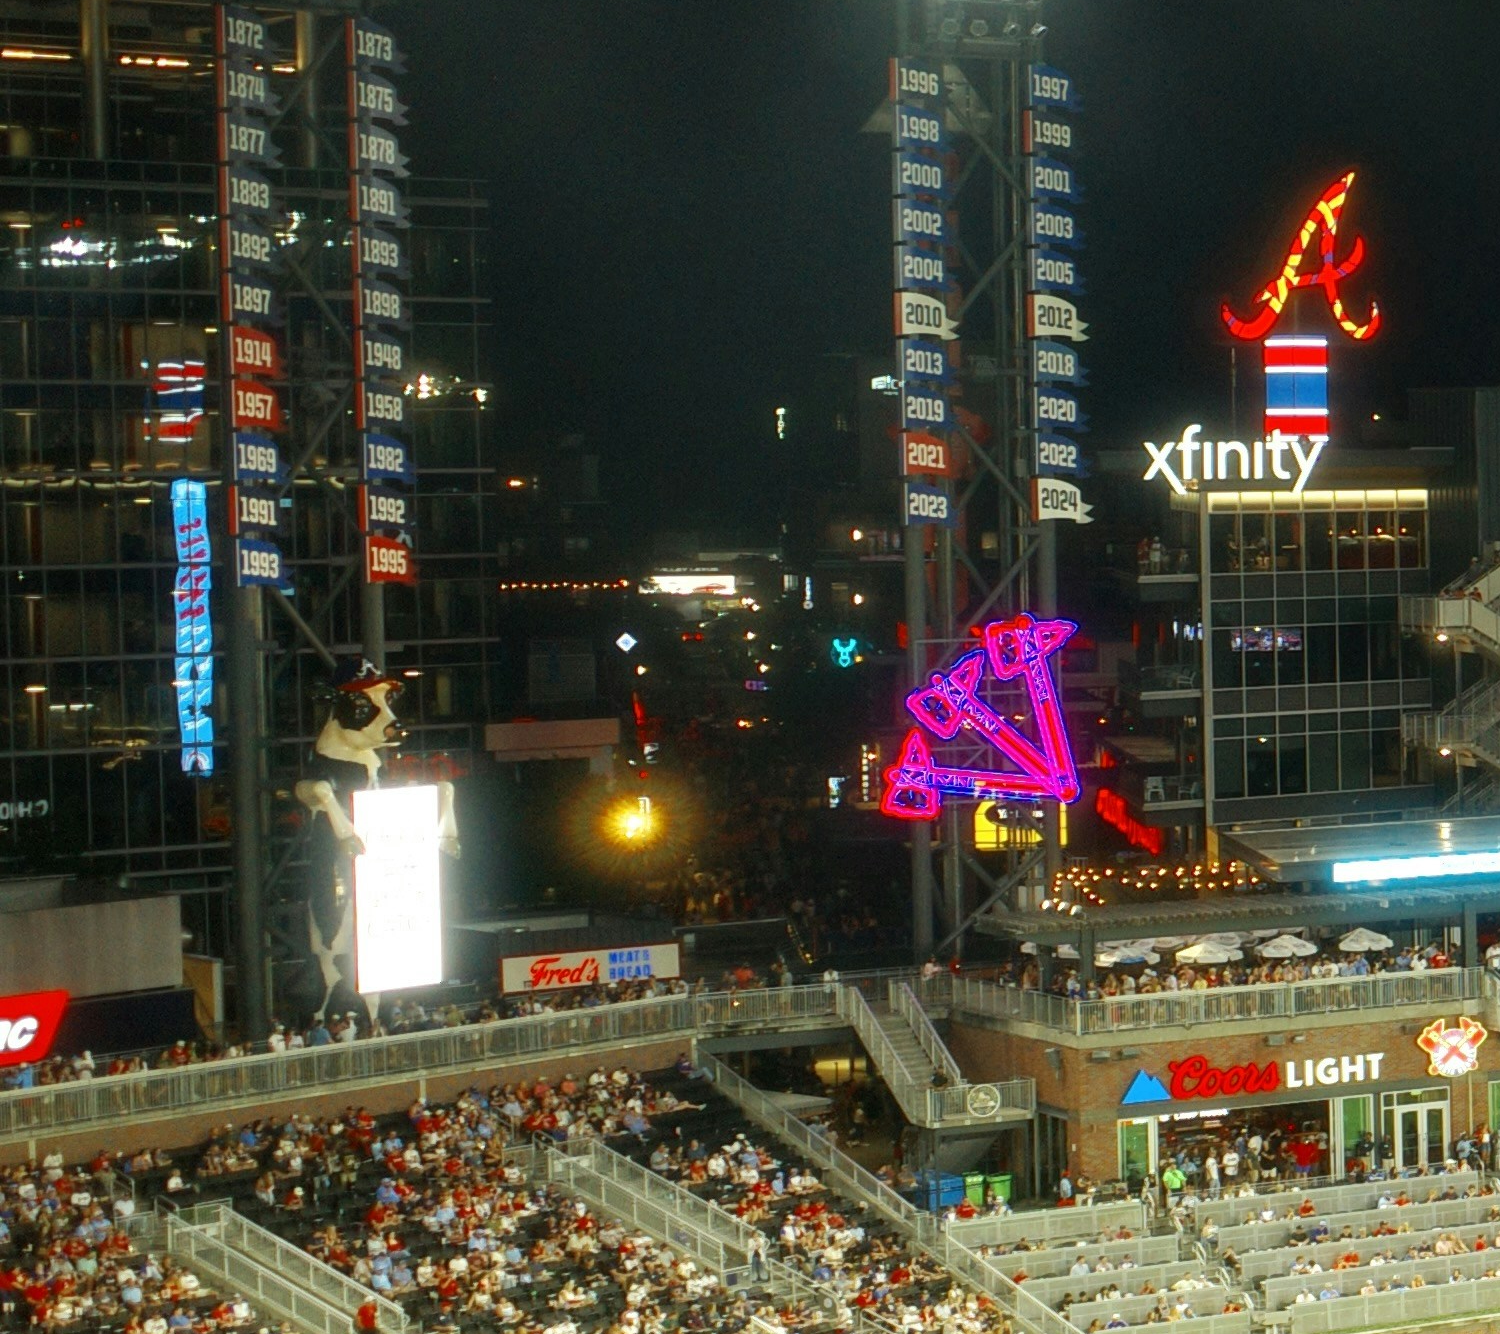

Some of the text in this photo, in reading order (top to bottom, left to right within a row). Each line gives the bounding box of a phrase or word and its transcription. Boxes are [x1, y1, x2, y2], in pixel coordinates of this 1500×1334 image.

[227, 17, 264, 49] 1872
[357, 30, 392, 61] 1873
[228, 70, 264, 102] 1874
[900, 68, 938, 96] 1996
[1034, 74, 1069, 101] 1997
[358, 82, 393, 112] 1875
[229, 124, 265, 155] 1877
[901, 115, 940, 143] 1998
[1035, 120, 1071, 147] 1999
[360, 134, 395, 164] 1878
[902, 162, 941, 189] 2000
[1035, 167, 1071, 193] 2001
[231, 177, 269, 208] 1883
[361, 186, 395, 216] 1891
[903, 209, 942, 236] 2002
[1036, 212, 1073, 238] 2003
[232, 230, 270, 262] 1892
[362, 238, 399, 267] 1893
[904, 256, 943, 282] 2004
[1037, 259, 1074, 284] 2005
[234, 283, 271, 315] 1897
[364, 288, 400, 319] 1898
[906, 302, 942, 328] 2010
[1038, 305, 1073, 330] 2012
[236, 337, 272, 368] 1914
[365, 340, 402, 370] 1948
[906, 349, 942, 375] 2013
[1038, 351, 1074, 376] 2018
[237, 391, 273, 420] 1957
[367, 393, 402, 422] 1958
[907, 396, 944, 422] 2019
[1040, 396, 1076, 422] 2020
[238, 443, 276, 473] 1969
[368, 443, 403, 472] 1982
[908, 442, 945, 469] 2021
[1040, 442, 1076, 468] 2022
[1143, 424, 1325, 495] xfinity
[240, 497, 277, 526] 1991
[370, 495, 405, 524] 1992
[909, 493, 947, 519] 2023
[1041, 488, 1078, 512] 2024
[241, 549, 279, 579] 1993
[371, 547, 407, 575] 1995
[608, 950, 650, 963] MEATS
[530, 957, 599, 987] Fred's
[609, 965, 651, 979] BREAD
[1168, 1053, 1384, 1099] Coors LIGHT
